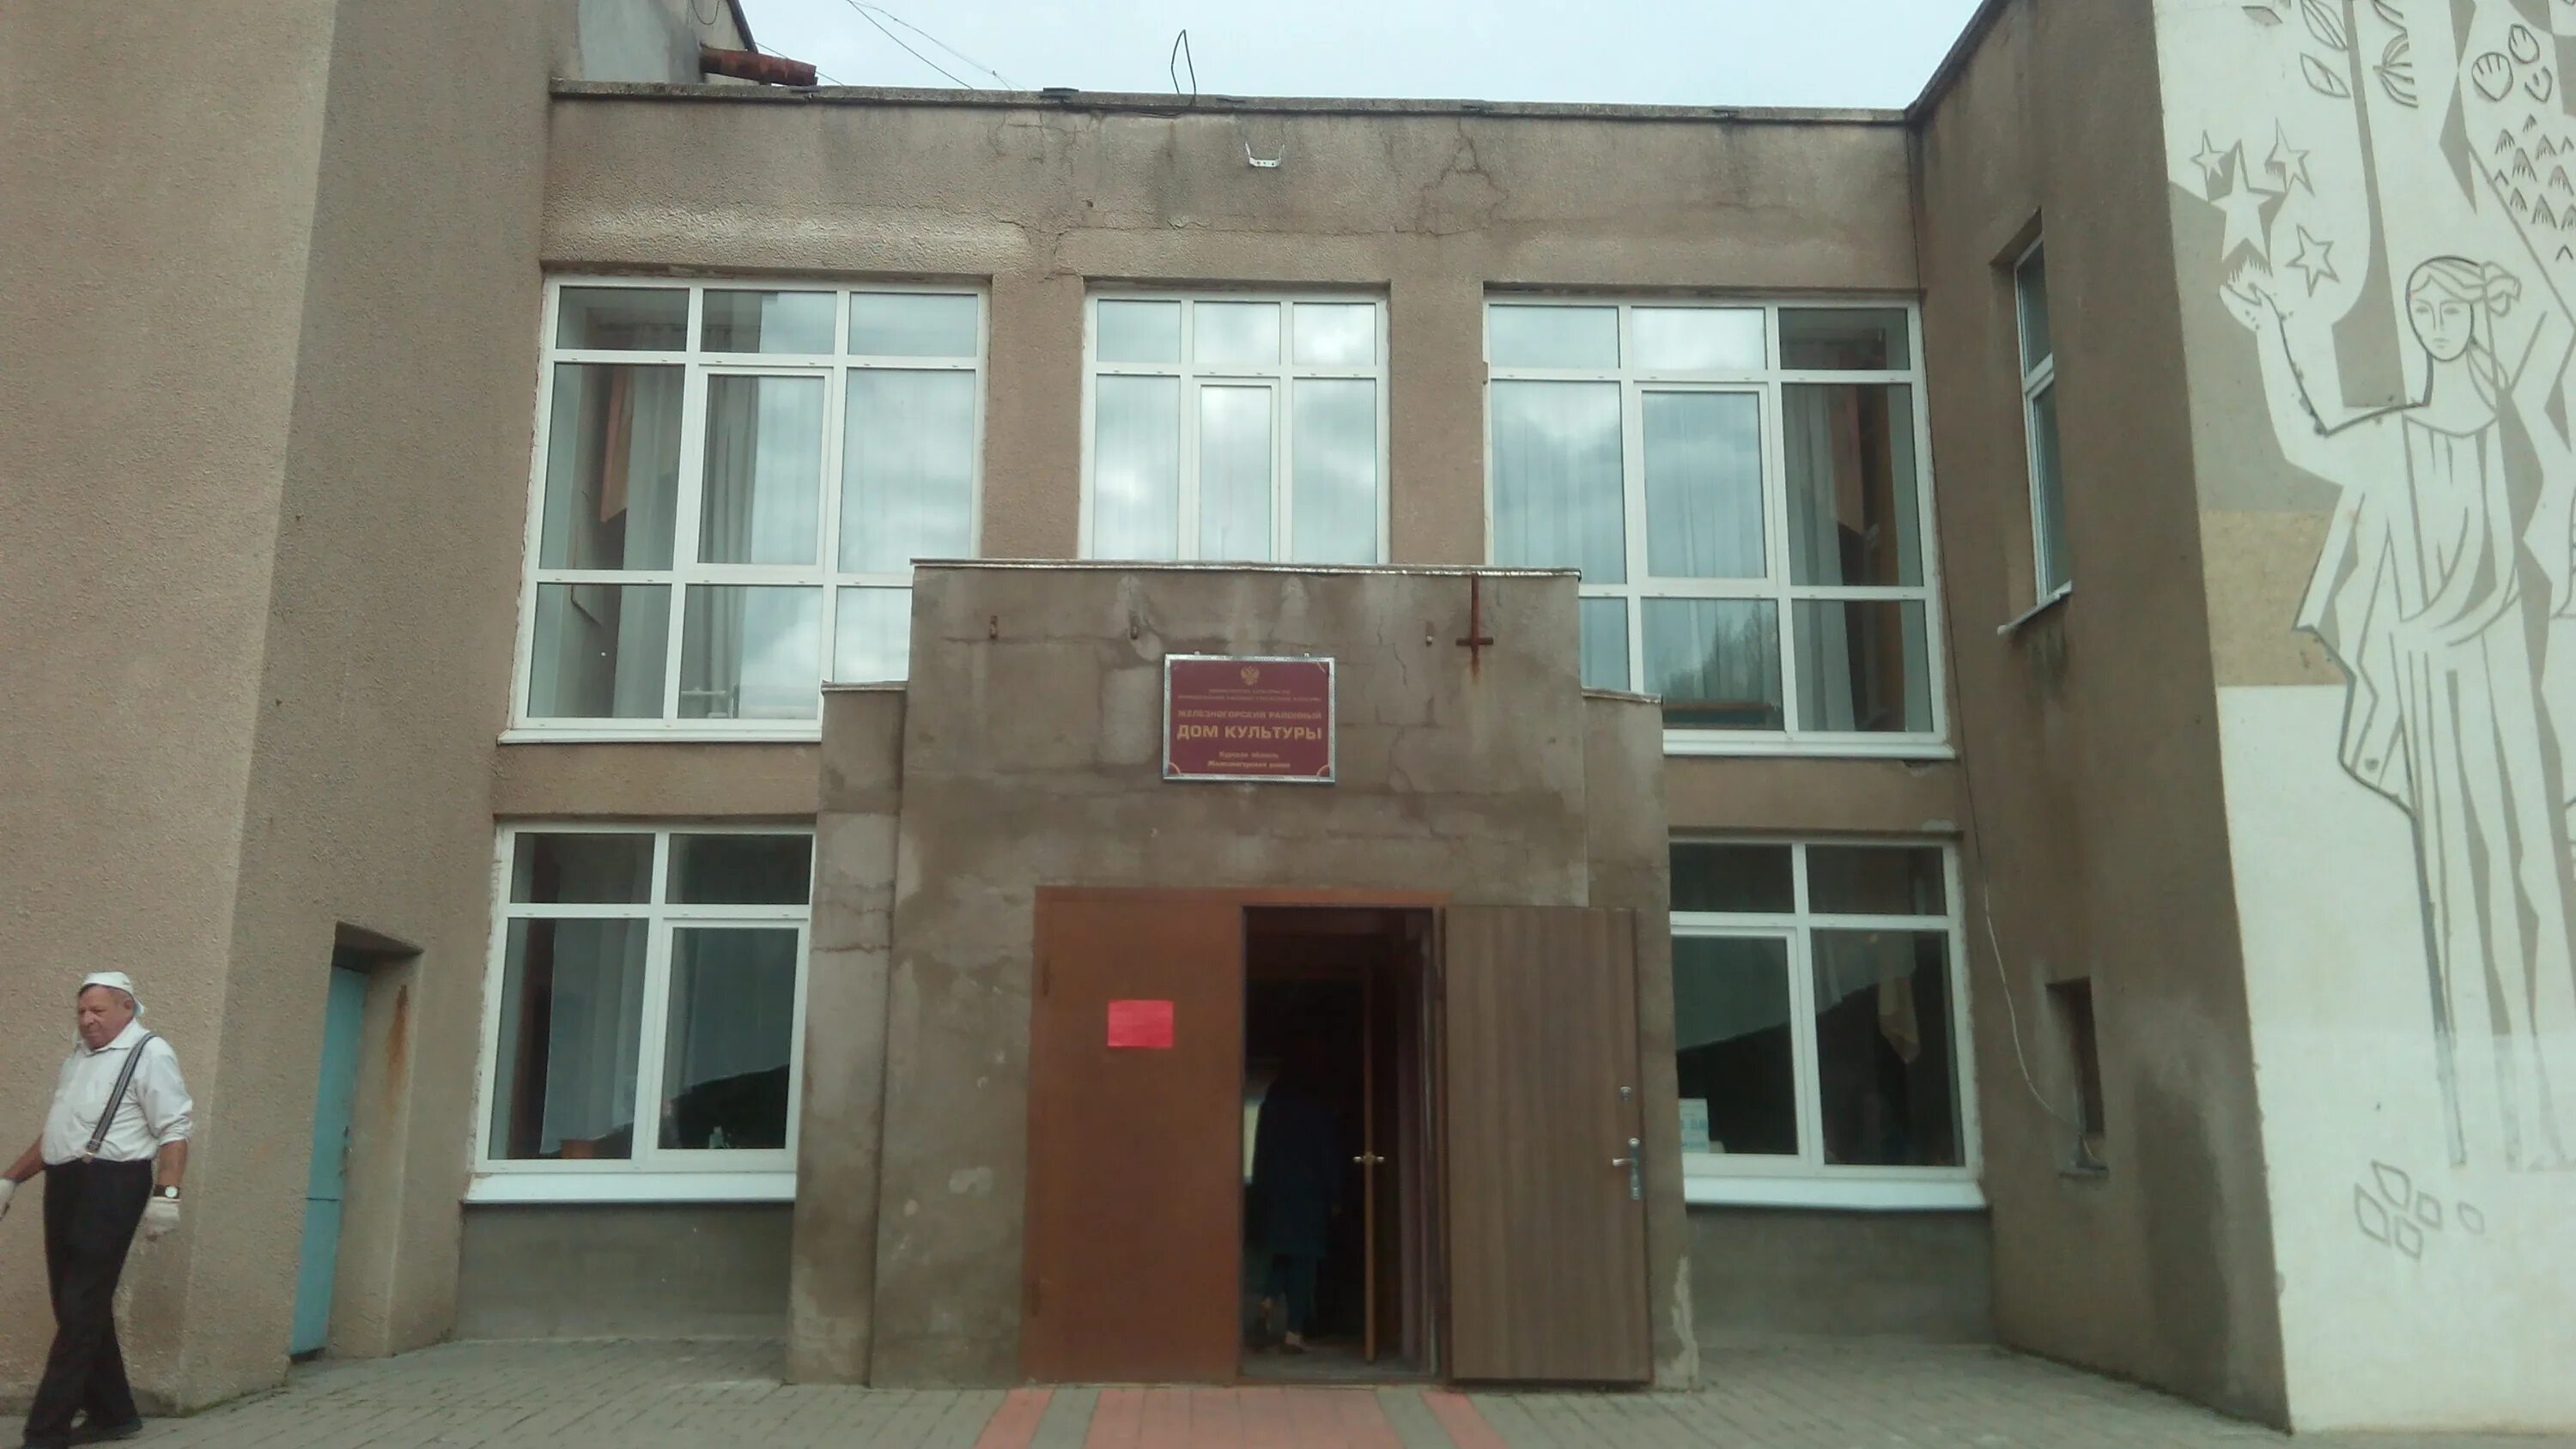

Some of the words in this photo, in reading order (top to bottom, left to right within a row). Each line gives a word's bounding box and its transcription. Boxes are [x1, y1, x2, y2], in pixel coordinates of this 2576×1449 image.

[1177, 709, 1266, 718] ЖЕЛЕЗНОГОРСКИЙ
[1268, 710, 1321, 720] РАЙОННЫЙ
[1176, 724, 1218, 740] ДОМ
[1224, 725, 1322, 741] КУЛЬТУРЫ
